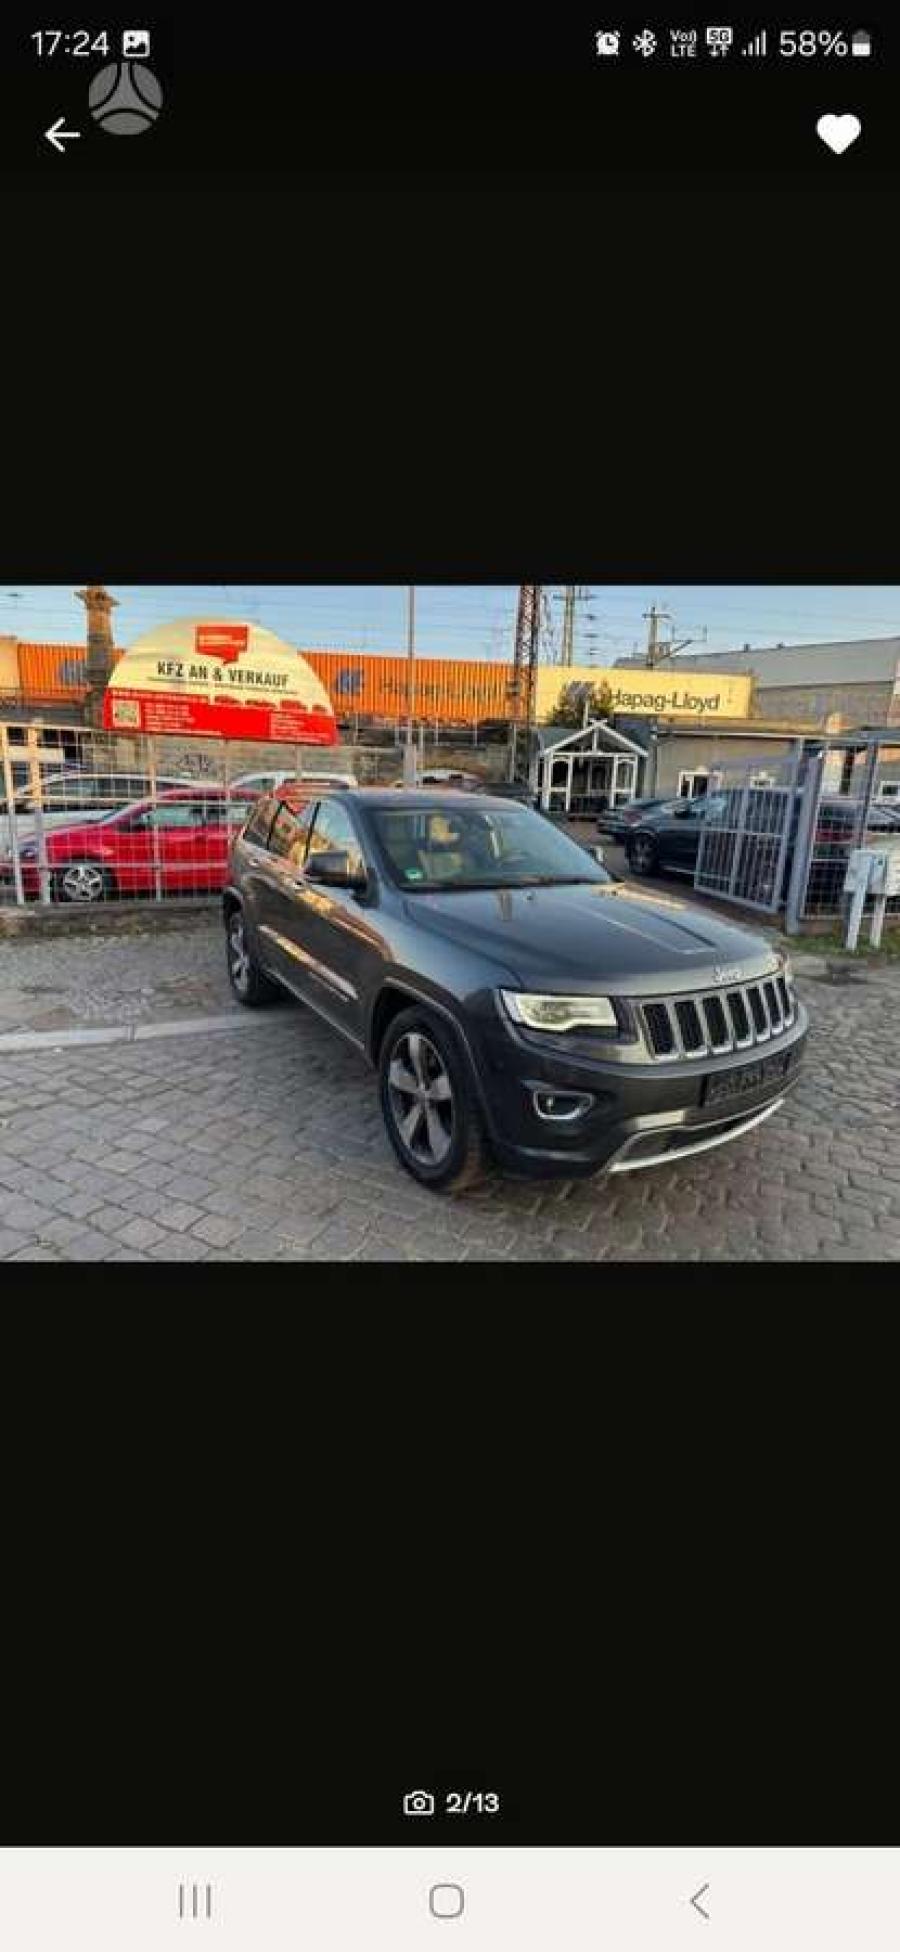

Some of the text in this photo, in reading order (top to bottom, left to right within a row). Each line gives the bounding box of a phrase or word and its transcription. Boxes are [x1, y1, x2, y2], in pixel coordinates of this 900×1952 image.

[157, 660, 184, 678] KFZ
[188, 663, 208, 680] AN
[213, 665, 222, 682] &
[228, 668, 289, 688] VERKAUF
